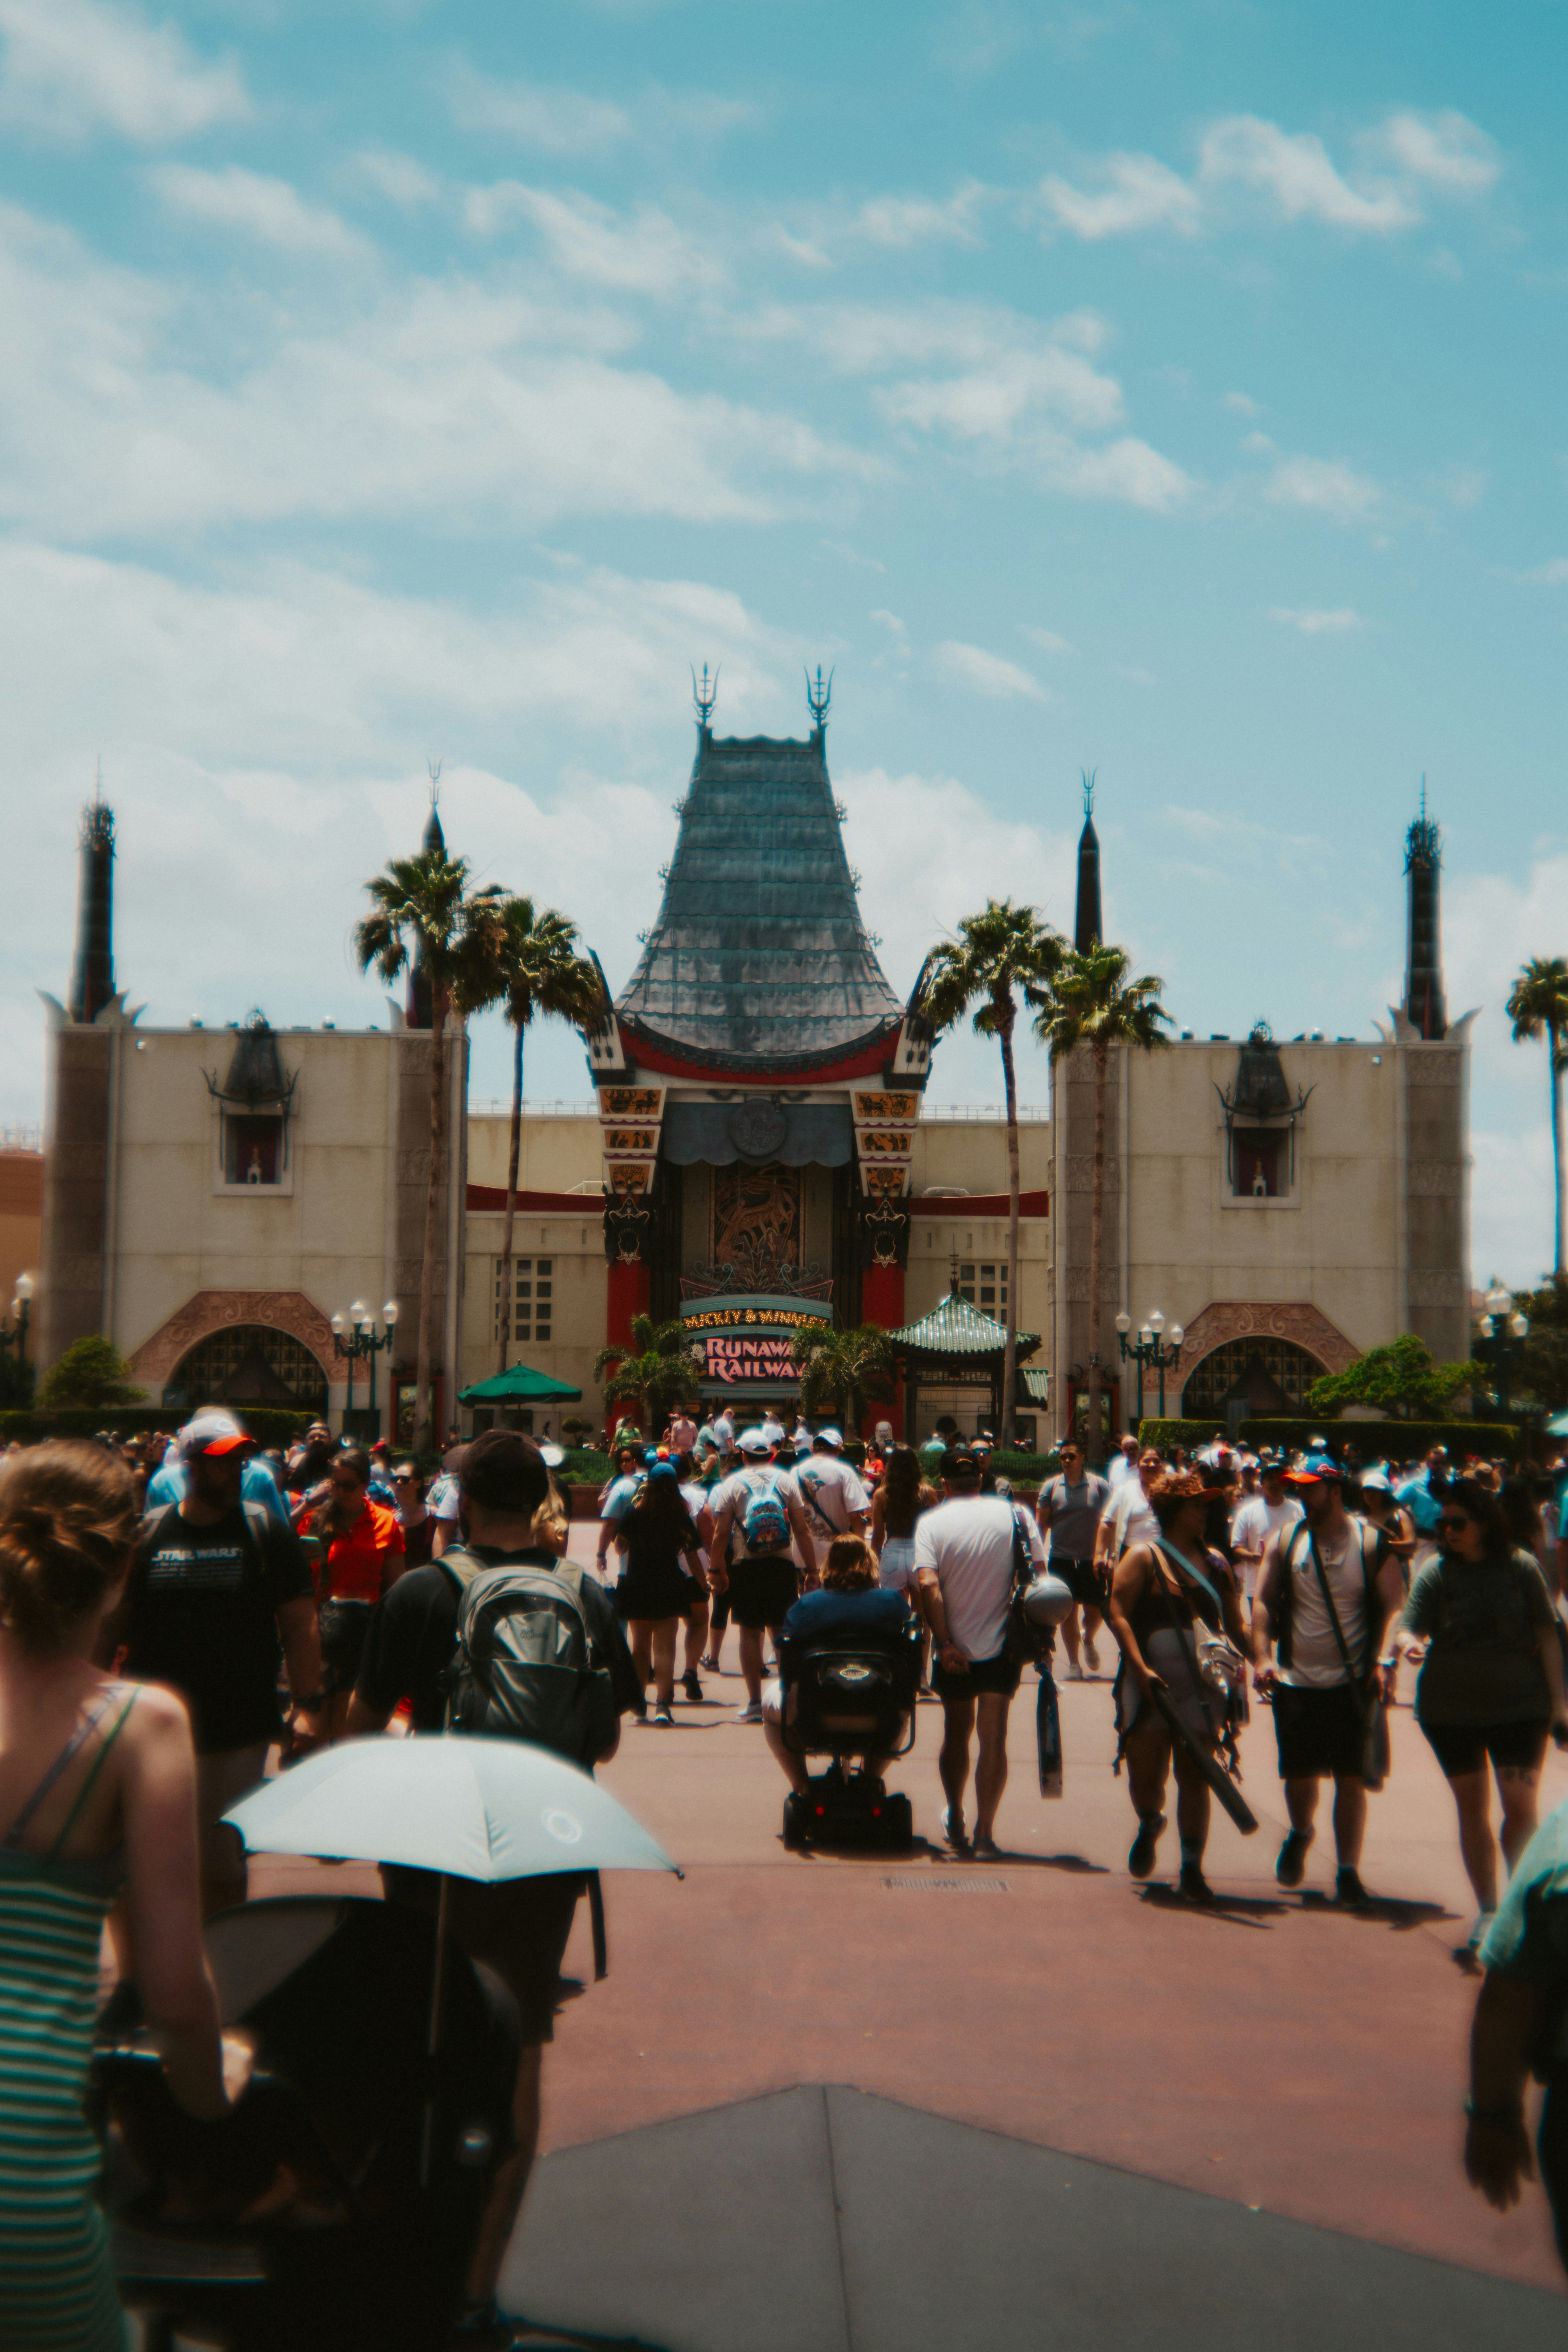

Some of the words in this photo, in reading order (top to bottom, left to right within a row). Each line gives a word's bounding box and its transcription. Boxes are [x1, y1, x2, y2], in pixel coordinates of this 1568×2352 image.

[684, 1310, 742, 1329] MICKEY
[745, 1309, 757, 1324] &
[707, 1337, 795, 1358] RUNAWA
[151, 1549, 195, 1561] STAR
